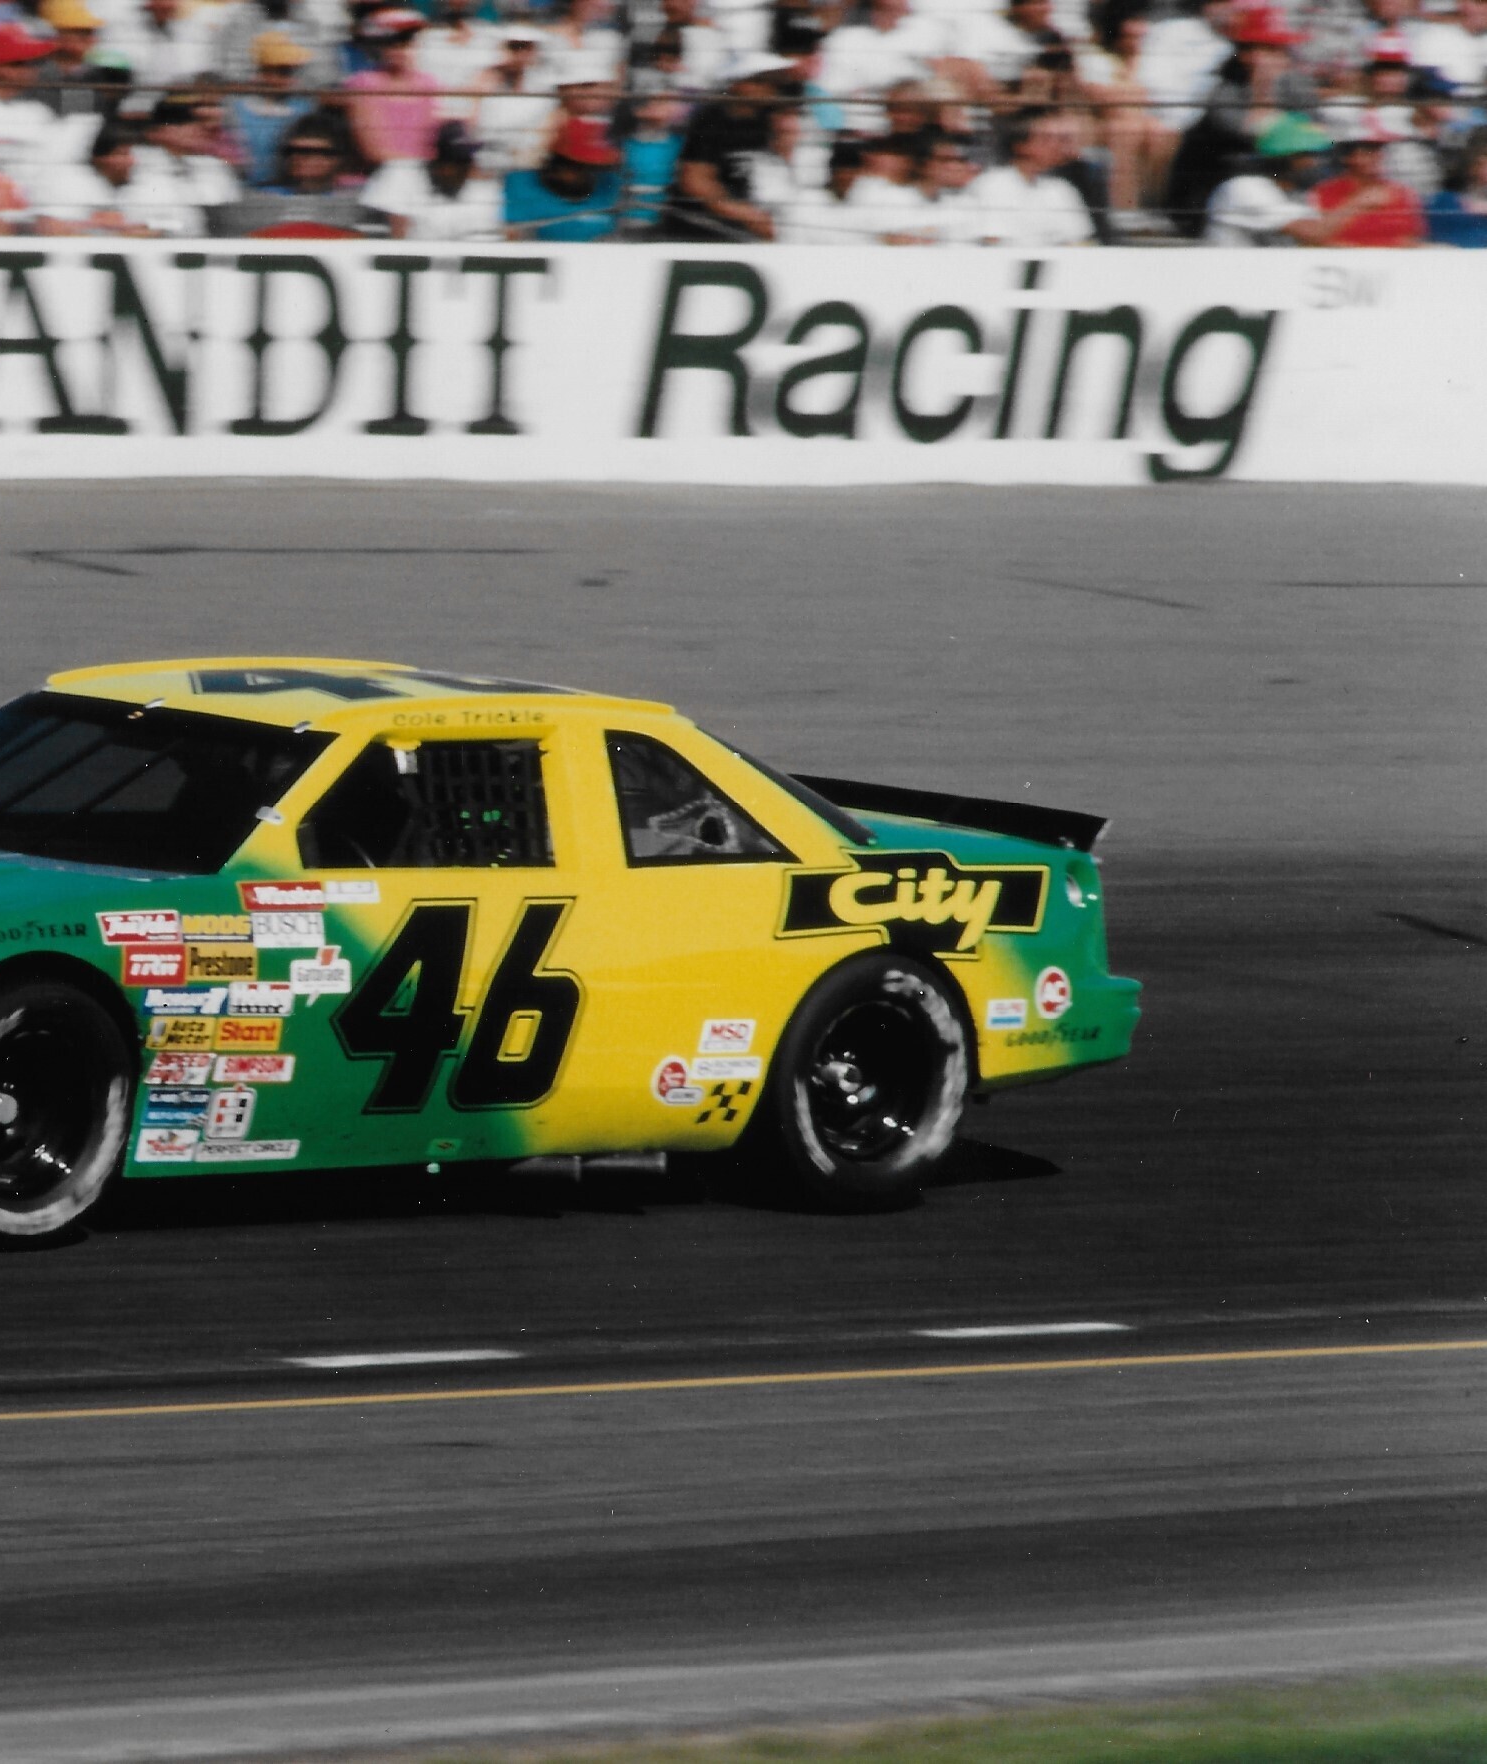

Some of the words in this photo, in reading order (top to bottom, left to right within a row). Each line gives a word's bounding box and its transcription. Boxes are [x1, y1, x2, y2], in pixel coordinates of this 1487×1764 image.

[633, 259, 1281, 482] Racing
[392, 712, 447, 727] Cole
[462, 710, 546, 725] Trickle
[828, 867, 1003, 951] City
[182, 914, 251, 935] MOOG
[252, 912, 323, 936] BUSCH
[129, 953, 182, 977] TRW
[189, 945, 254, 977] Prestone
[331, 898, 585, 1112] 46
[170, 1020, 206, 1033] Auto
[220, 1021, 277, 1042] Stant
[710, 1023, 749, 1041] MSD
[166, 1033, 211, 1046] Meter
[224, 1056, 286, 1074] SIMPSON
